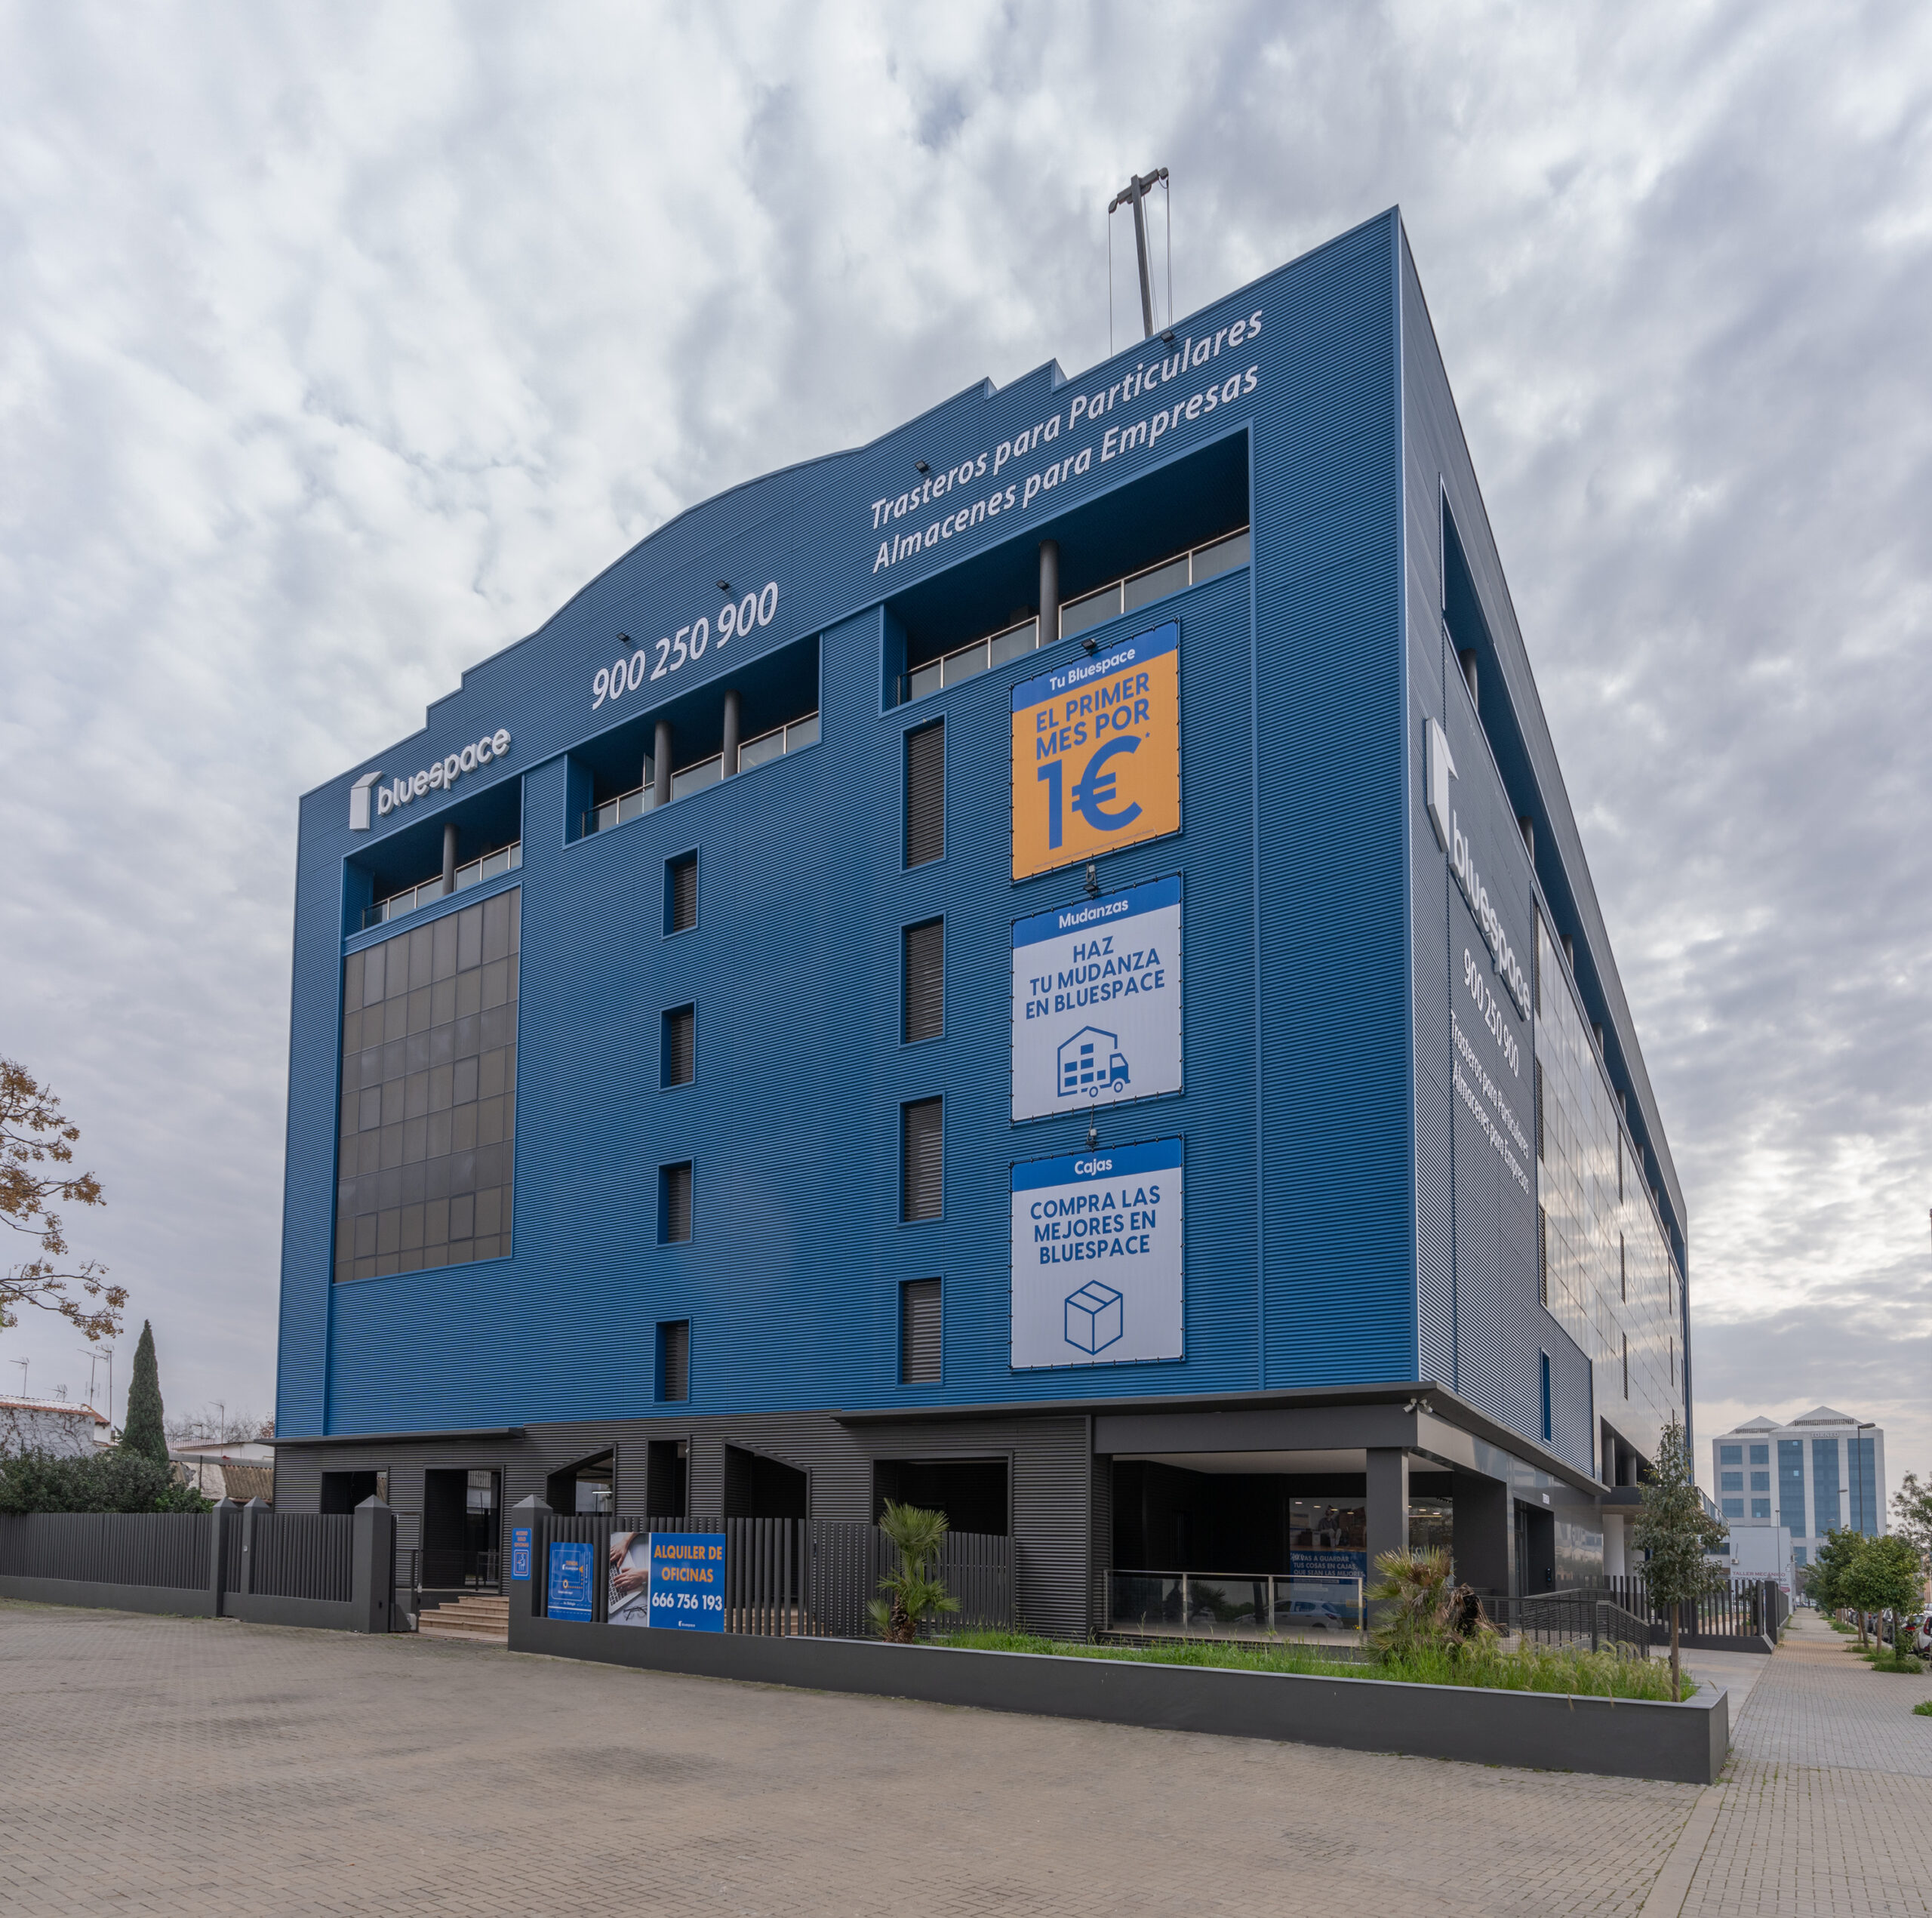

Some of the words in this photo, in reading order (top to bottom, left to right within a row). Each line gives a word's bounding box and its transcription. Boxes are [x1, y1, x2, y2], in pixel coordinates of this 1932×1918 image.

[871, 452, 988, 530] Trasteros
[993, 414, 1061, 476] para
[1068, 310, 1263, 430] Particulares
[872, 484, 1017, 574] Almacenes
[1023, 448, 1092, 510] para
[1100, 365, 1259, 463] Empresas
[592, 650, 645, 710] 900
[650, 617, 709, 682] 250
[717, 581, 778, 649] 900
[1050, 676, 1066, 691] Tu
[1068, 648, 1136, 685] Bluespace
[1036, 707, 1059, 734] EL
[1066, 672, 1150, 722] PRIMER
[1036, 721, 1088, 761] MES
[1095, 698, 1150, 739] POR
[378, 728, 512, 816] bluespace
[1058, 899, 1129, 929] Mudanzas
[1451, 808, 1531, 1021] bluespace
[1029, 974, 1052, 996] TU
[1058, 947, 1161, 990] MUDANZA
[1073, 935, 1114, 964] HAZ
[1026, 997, 1049, 1021] EN
[1054, 968, 1165, 1014] BLUESPACE
[1464, 947, 1484, 1011] 900
[1484, 987, 1503, 1047] 250
[1503, 1024, 1519, 1078] 900
[1451, 1008, 1482, 1084] Trasteros
[1453, 1059, 1490, 1135] Almacenes
[1074, 1158, 1113, 1176] Cajas
[1030, 1191, 1116, 1221] COMPRA
[1121, 1185, 1161, 1208] LAS
[1034, 1214, 1124, 1242] MEJORES
[1131, 1209, 1156, 1230] EN
[1039, 1234, 1150, 1264] BLUESPACE
[654, 1544, 706, 1560] ALQUILER
[708, 1546, 722, 1560] DE
[661, 1566, 714, 1583] OFICINAS
[652, 1592, 675, 1608] 666
[677, 1593, 699, 1610] 756
[702, 1595, 723, 1611] 193
